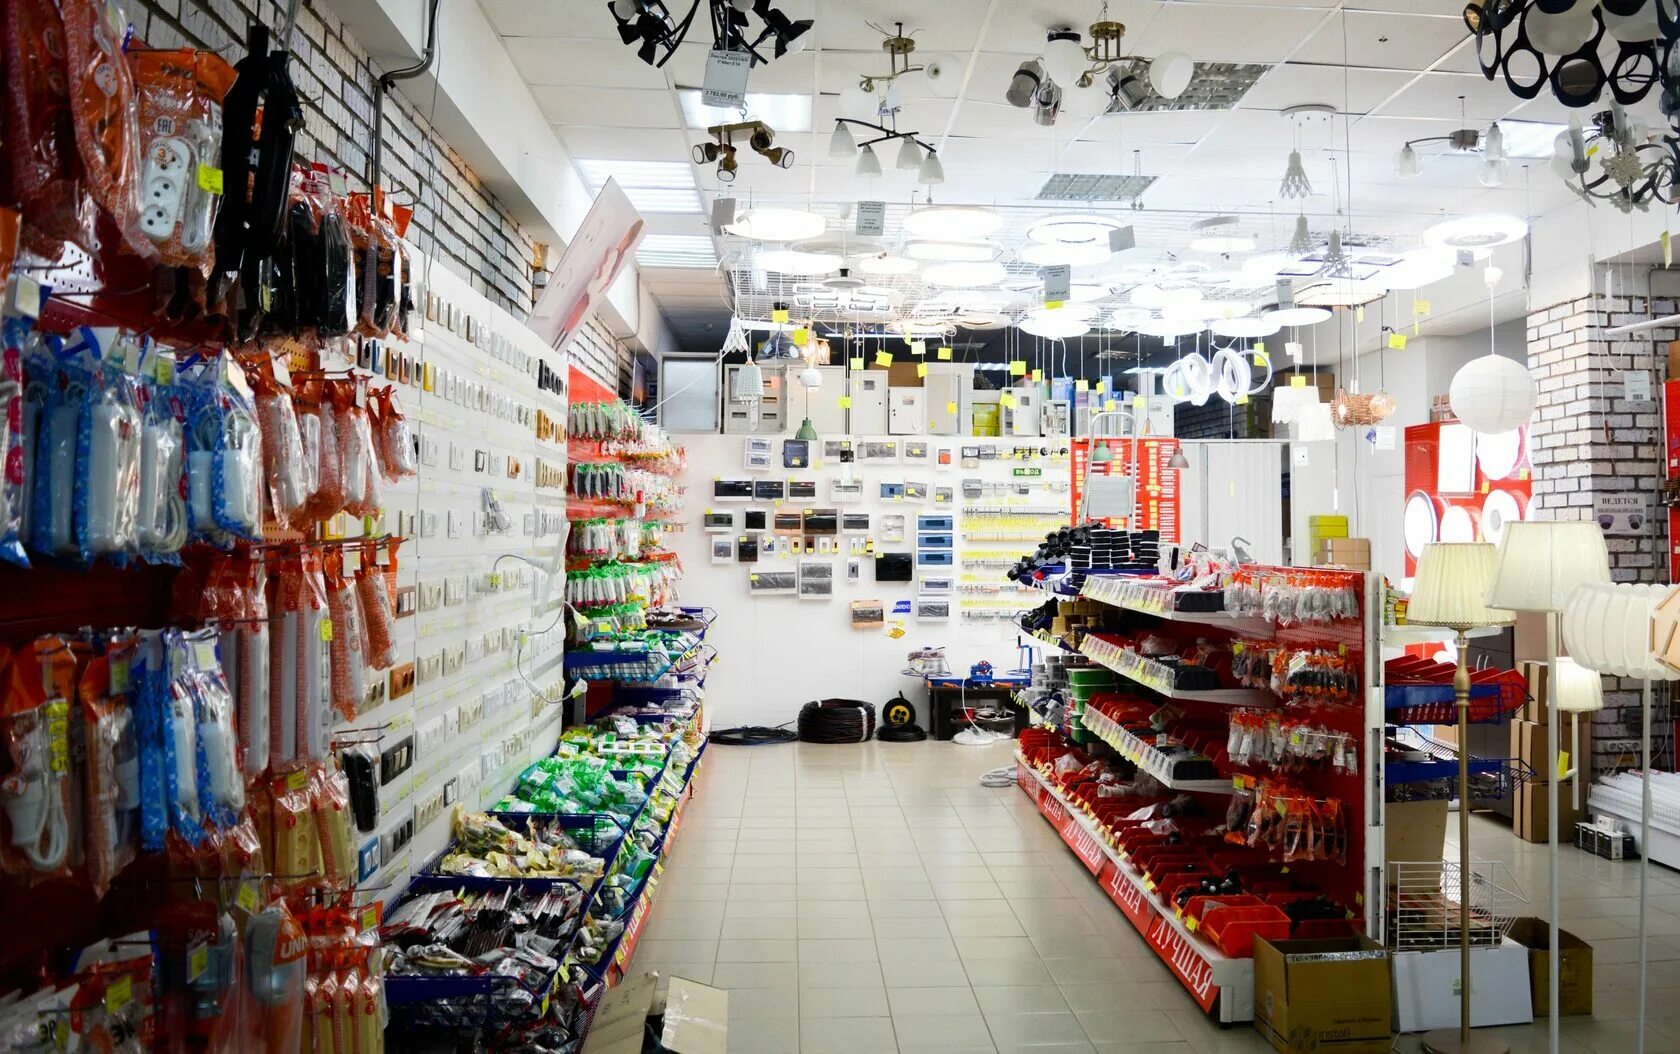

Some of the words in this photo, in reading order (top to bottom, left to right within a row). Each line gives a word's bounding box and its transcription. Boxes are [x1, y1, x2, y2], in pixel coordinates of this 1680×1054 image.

[1601, 497, 1639, 505] ВЕДЕТСЯ
[1043, 793, 1064, 822] ЦЕНА
[1063, 819, 1103, 868] ЛУЧШАЯ
[1110, 867, 1142, 915] ЦЕНА
[1151, 919, 1213, 1001] ЛУЧШАЯ
